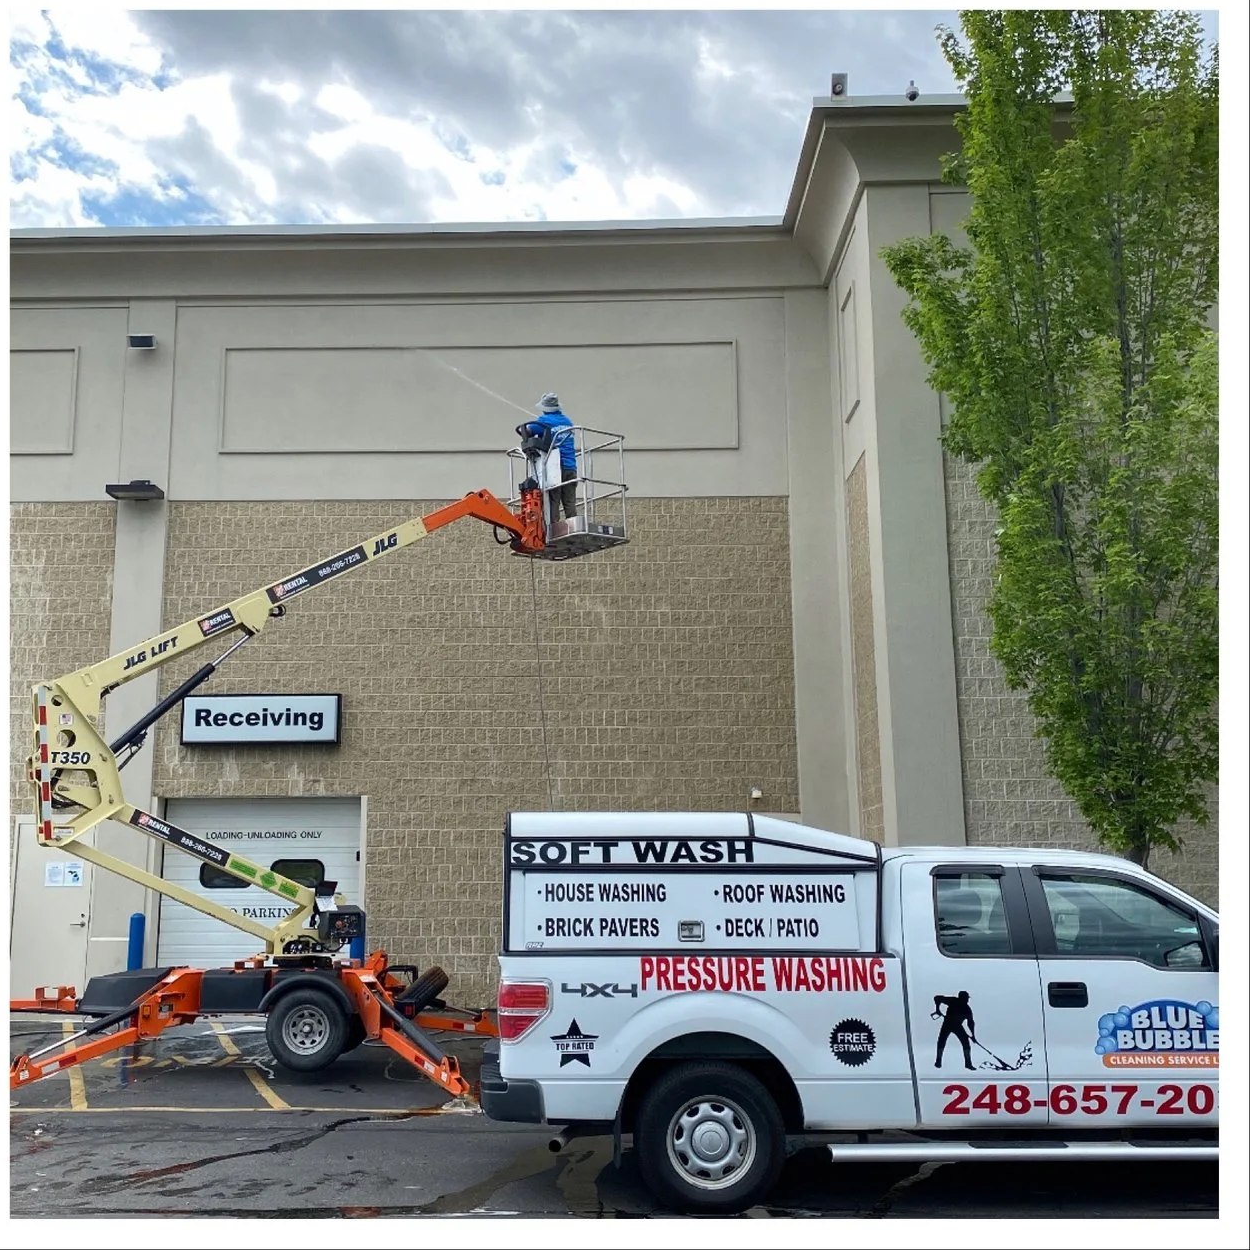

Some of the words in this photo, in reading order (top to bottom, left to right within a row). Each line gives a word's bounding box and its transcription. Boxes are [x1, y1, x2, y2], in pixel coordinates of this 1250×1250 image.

[373, 533, 398, 556] JLG
[283, 576, 308, 591] RENTAL
[209, 612, 231, 626] RENTAL
[123, 651, 147, 670] JLG
[150, 636, 178, 657] LIFT
[194, 708, 324, 731] Receiving
[51, 751, 91, 765] T350
[148, 819, 171, 835] RENTAL
[300, 830, 322, 839] ONLY
[512, 840, 617, 865] SOFT
[632, 840, 755, 864] WASH
[544, 883, 595, 903] HOUSE
[598, 883, 667, 903] WASHING
[723, 884, 766, 904] ROOF
[770, 884, 846, 904] WASHING
[242, 907, 297, 918] PARKIN
[544, 918, 593, 938] BRICK
[599, 918, 660, 938] PAVERS
[725, 918, 764, 938] DECK
[777, 918, 820, 938] PATIO
[640, 956, 767, 992] PRESSURE
[772, 956, 887, 992] WASHING
[1131, 1005, 1205, 1029] BLUE
[556, 1043, 570, 1051] TOP
[571, 1042, 595, 1050] RATED
[836, 1032, 868, 1044] FREE
[833, 1043, 874, 1054] ESTIMATE
[1110, 1055, 1165, 1065] CLEANING
[1168, 1055, 1211, 1065] SERVICE
[942, 1084, 1219, 1115] 248-657-20
